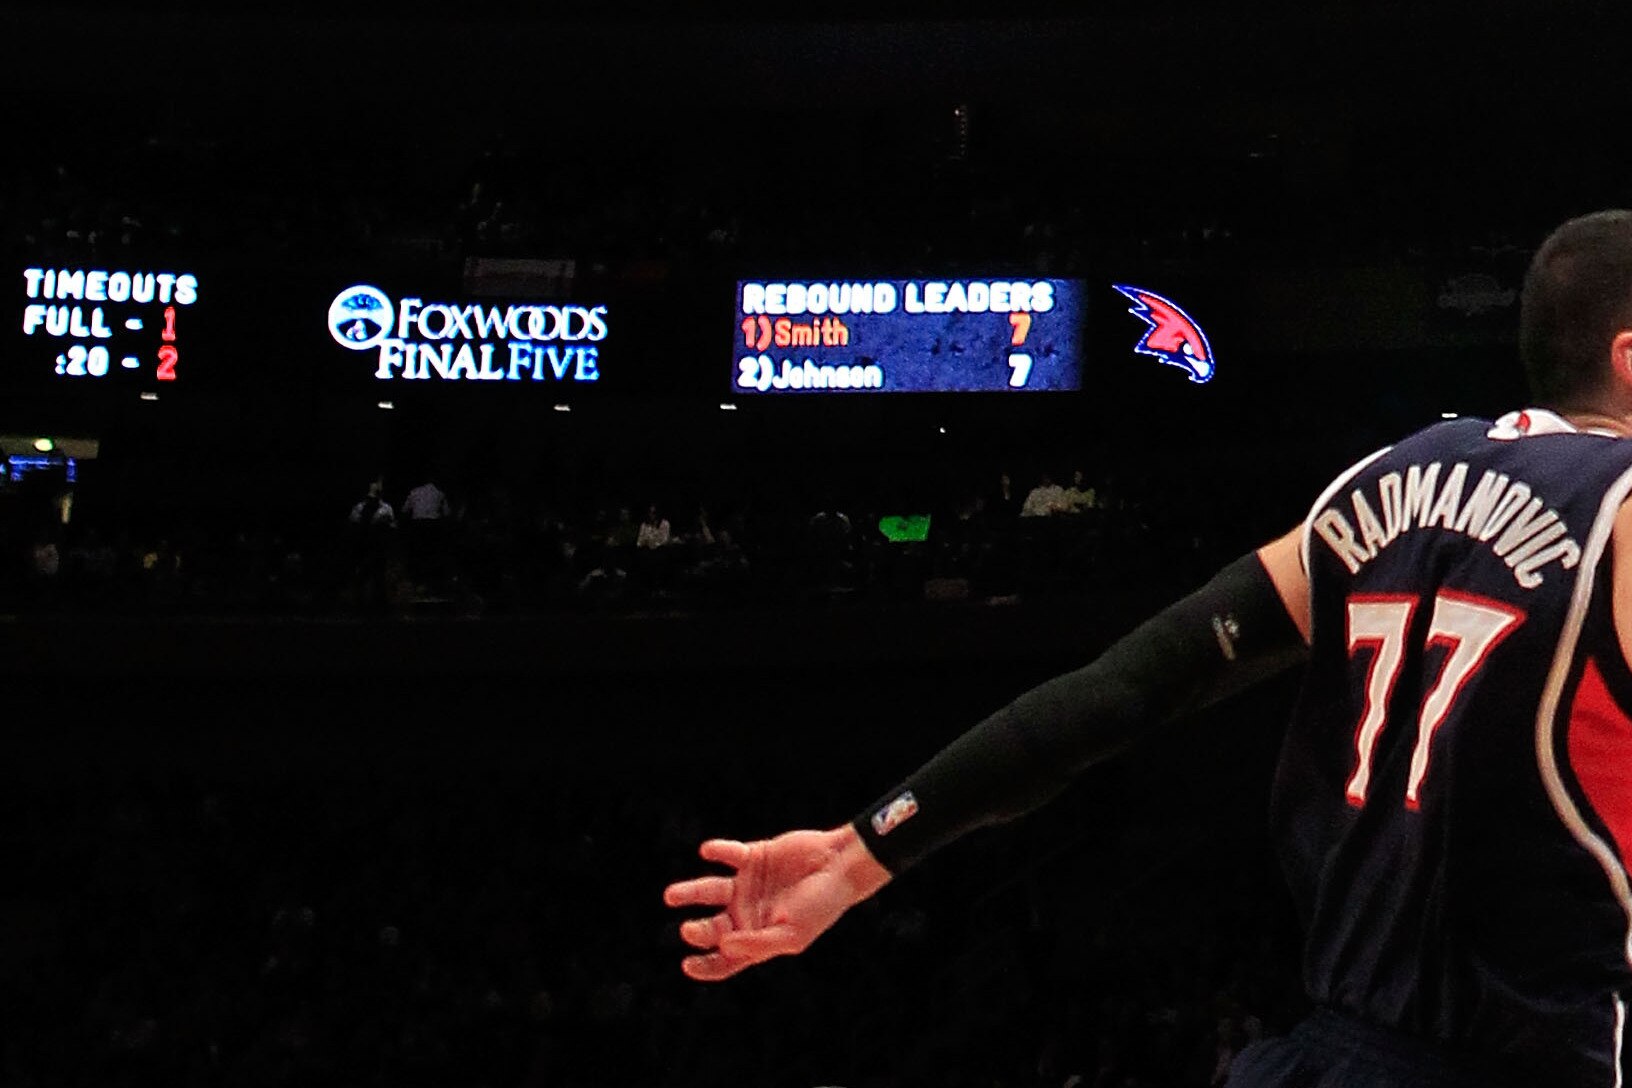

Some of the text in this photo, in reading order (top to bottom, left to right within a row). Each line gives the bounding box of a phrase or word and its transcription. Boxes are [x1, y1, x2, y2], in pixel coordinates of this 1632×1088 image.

[23, 268, 198, 305] TIMEOUTS
[742, 282, 1054, 313] REBOUND LEADERS
[23, 305, 112, 338] FULL
[162, 306, 176, 341] 1
[398, 298, 608, 341] FOXWOODS
[1009, 313, 1031, 347] 7
[55, 345, 109, 376] :20
[157, 345, 178, 380] 2
[375, 339, 600, 380] FINAL FIVE
[1008, 353, 1032, 388] 7
[1314, 462, 1582, 589] RADMANOVIC
[1346, 589, 1528, 811] 77
